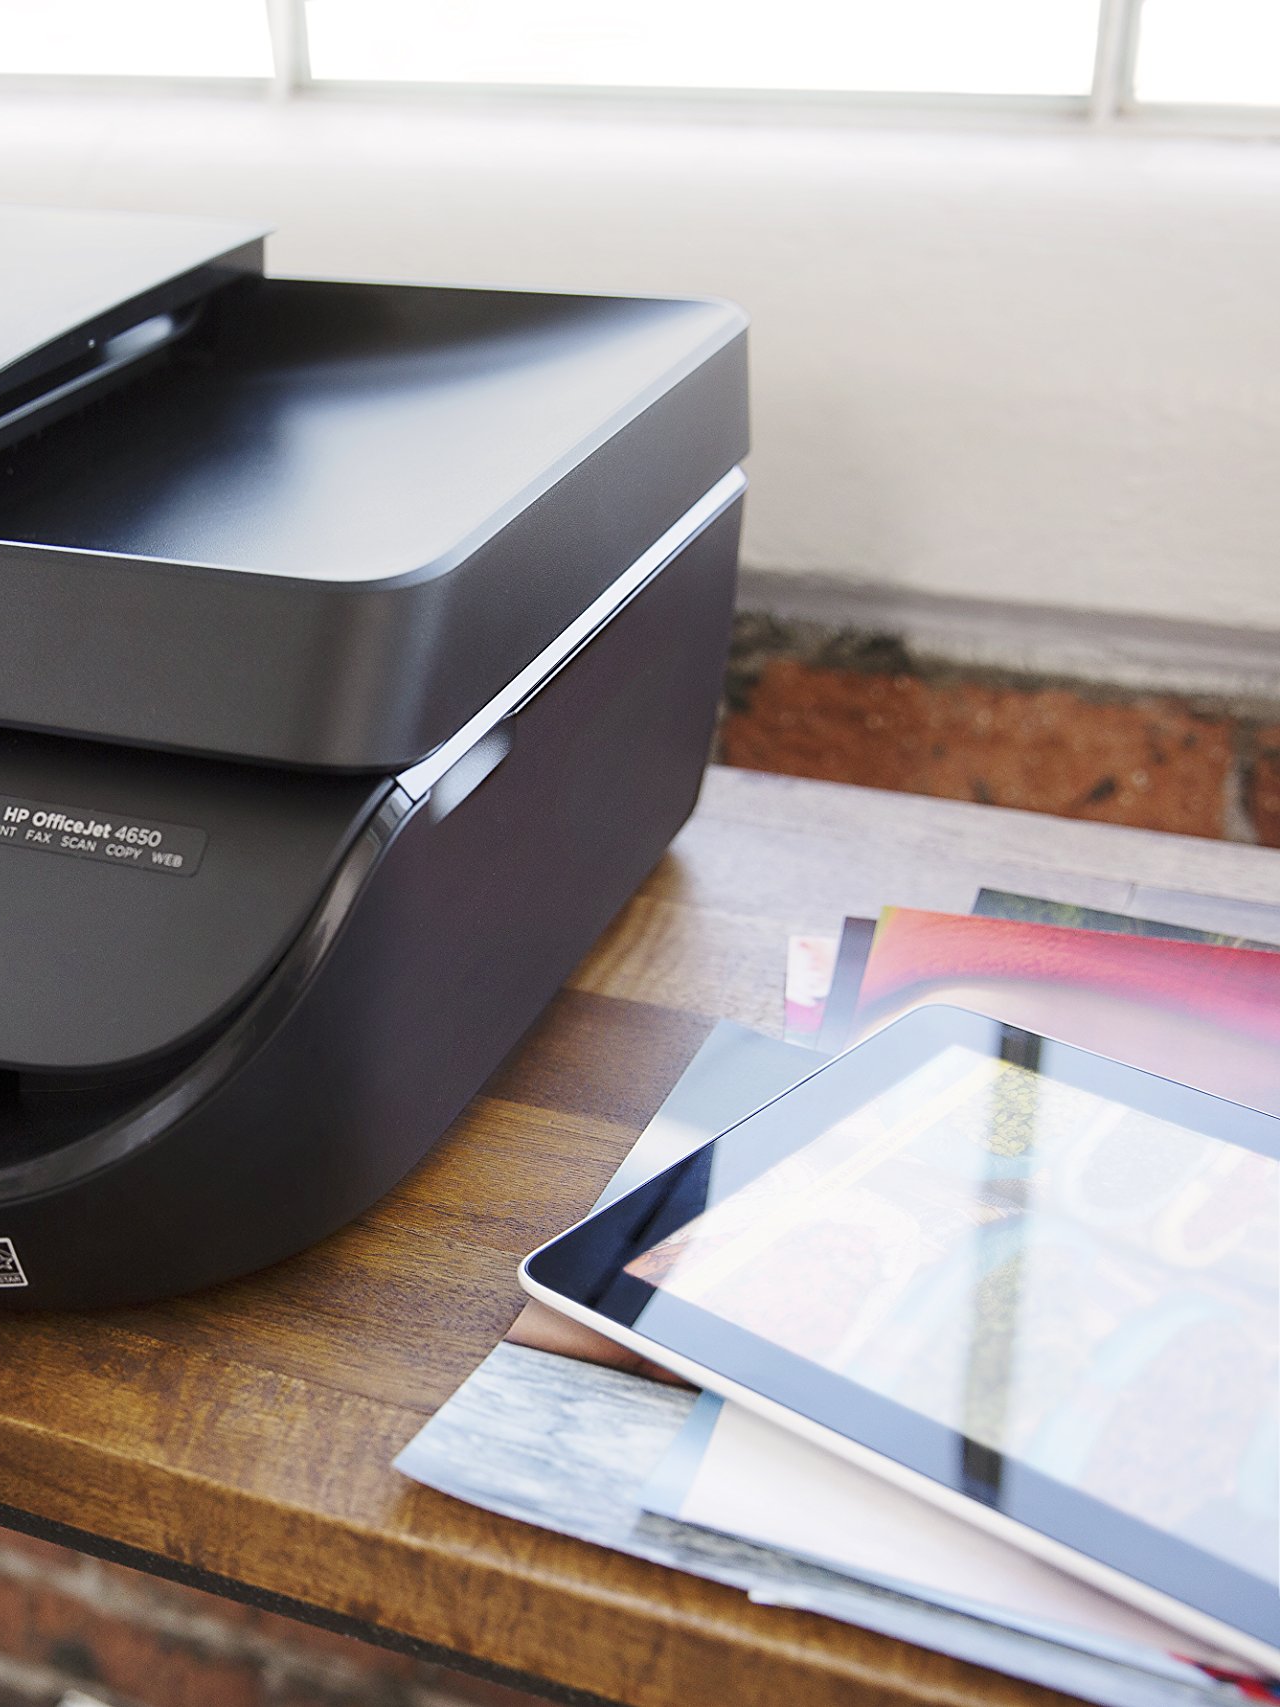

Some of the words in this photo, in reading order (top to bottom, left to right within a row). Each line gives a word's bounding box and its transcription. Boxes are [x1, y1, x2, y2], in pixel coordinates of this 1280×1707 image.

[3, 806, 30, 823] HP
[32, 811, 113, 839] OfficeJet
[114, 825, 162, 848] 4650
[25, 829, 53, 844] FAX
[60, 835, 97, 852] SCAN
[105, 843, 143, 860] COPY
[151, 851, 184, 868] WEB
